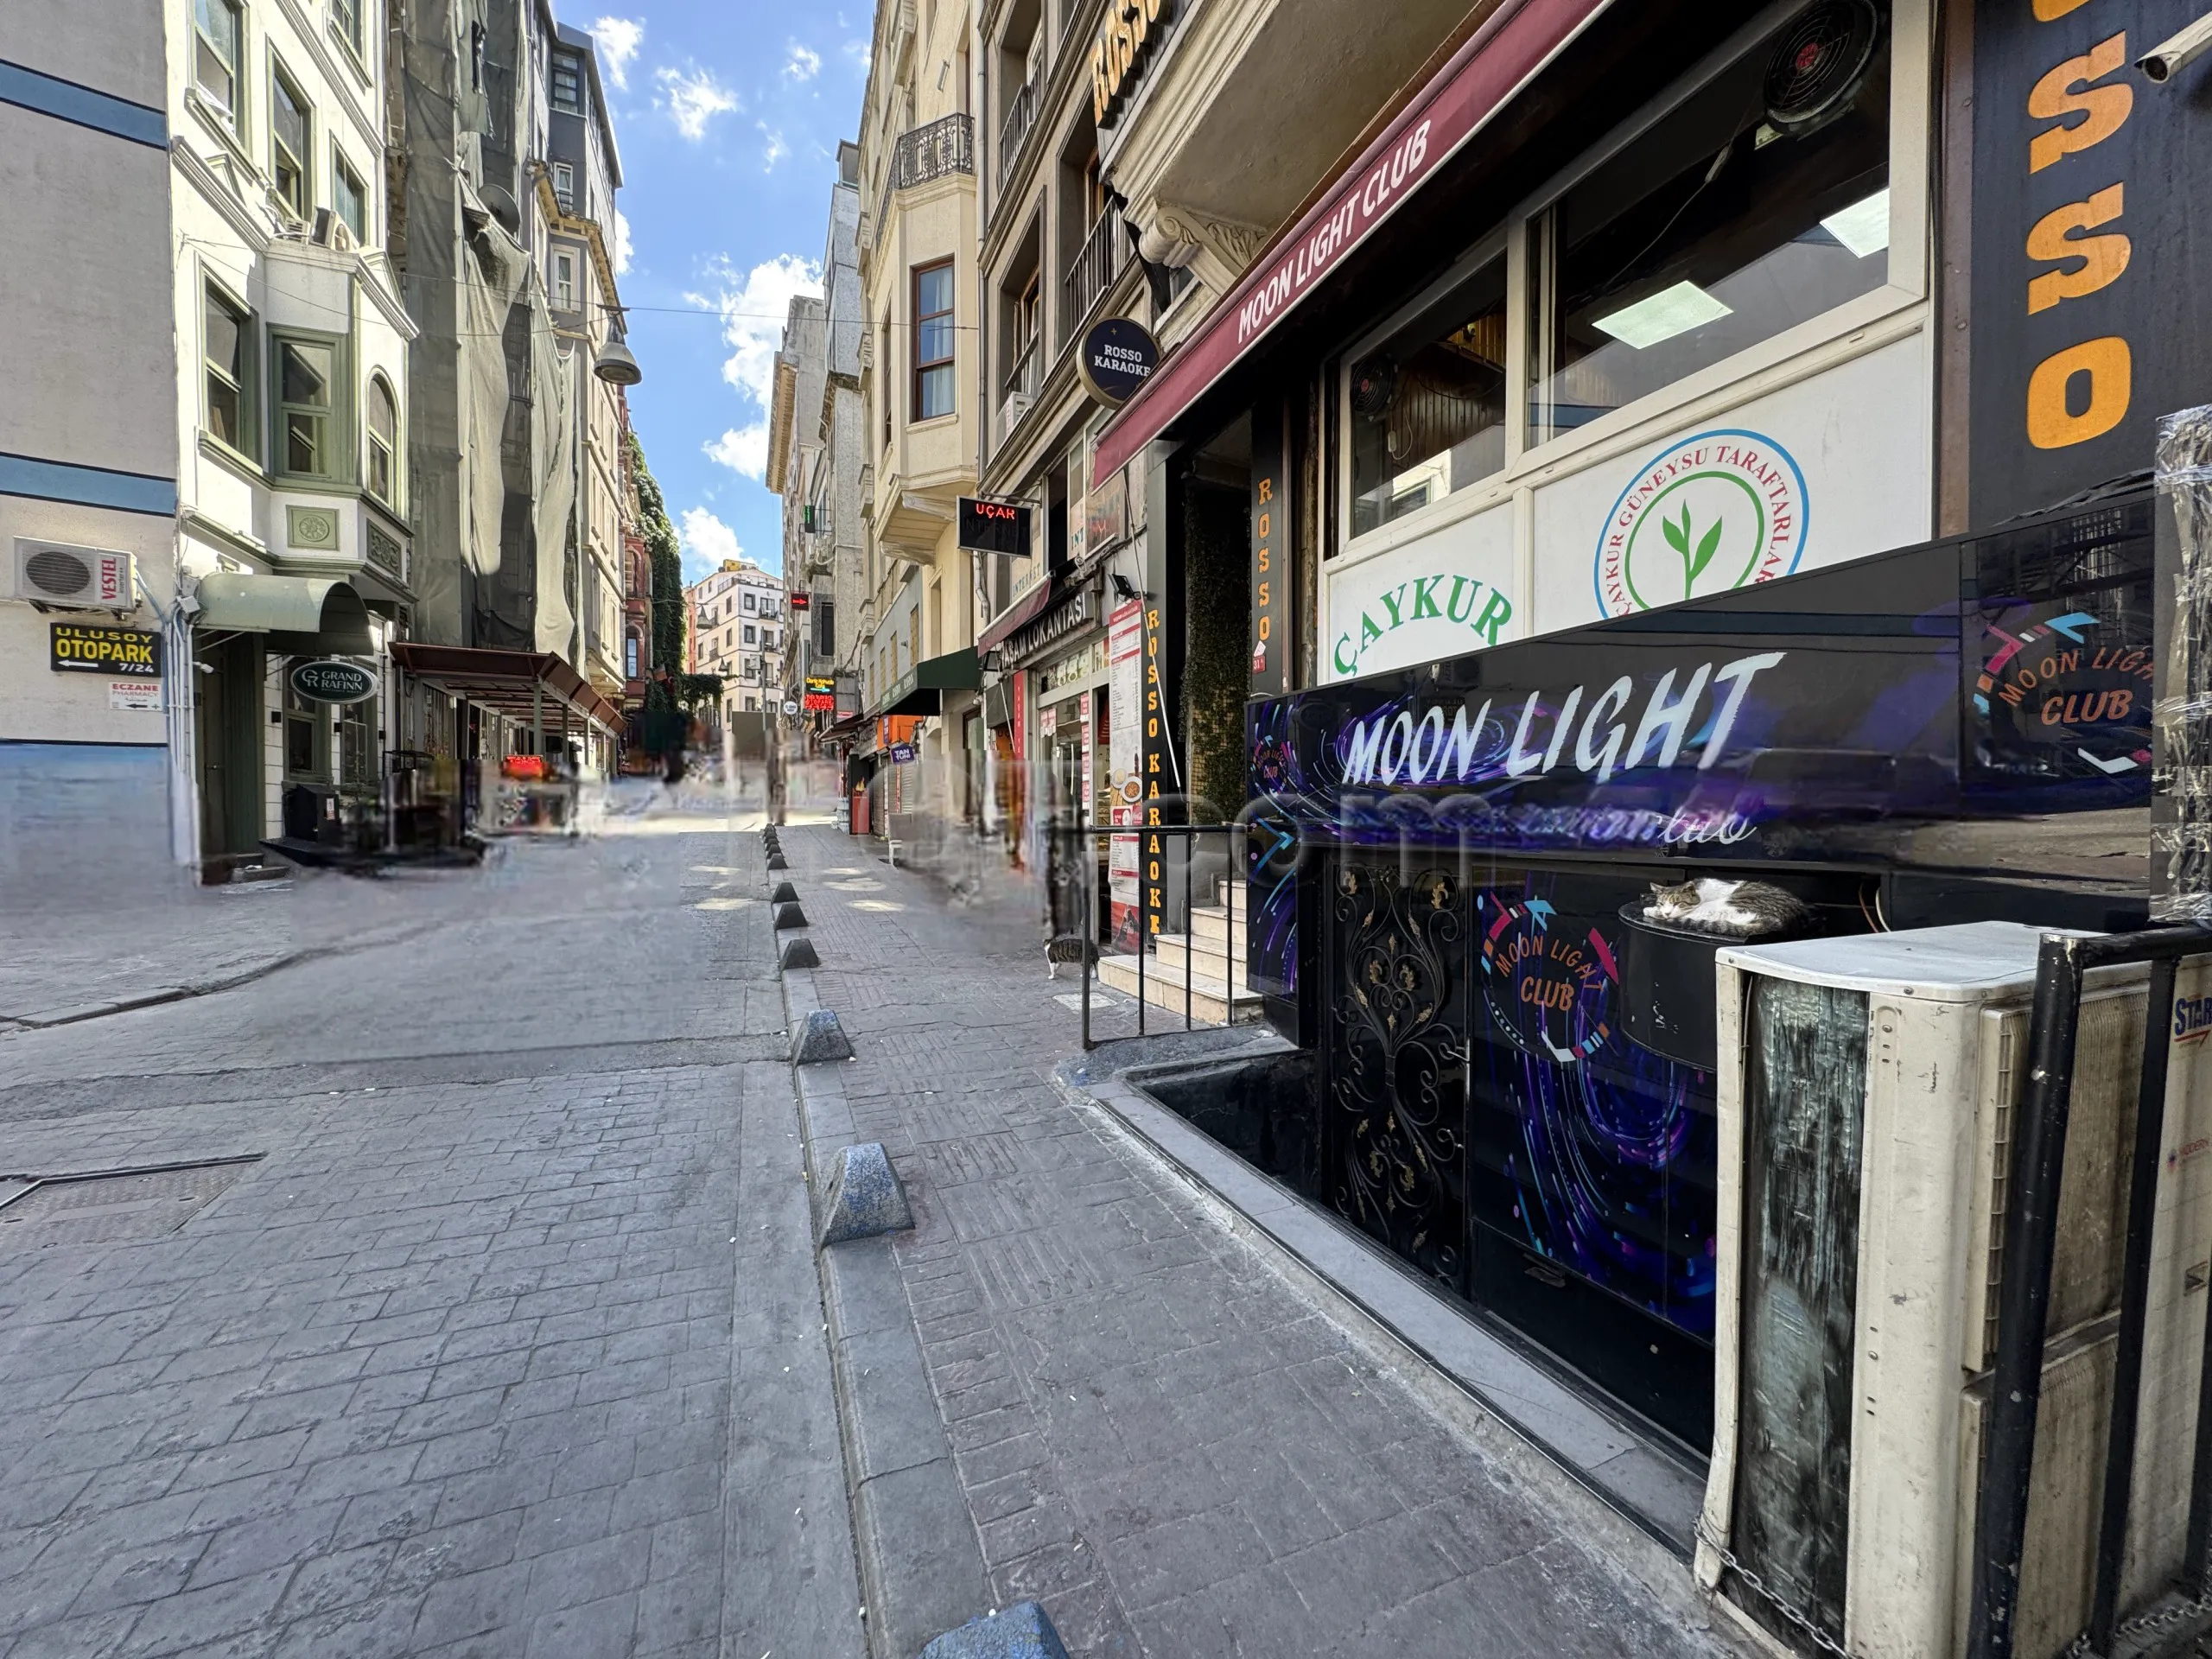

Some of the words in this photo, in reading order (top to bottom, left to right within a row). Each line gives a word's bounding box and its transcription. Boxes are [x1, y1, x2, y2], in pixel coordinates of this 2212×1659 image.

[1090, 0, 1160, 127] ROSS
[1238, 270, 1293, 345] MOON
[1296, 190, 1360, 286] LIGHT
[1363, 119, 1431, 218] CLUB
[2026, 0, 2133, 449] SSO
[1095, 355, 1151, 377] KARAOKE
[1104, 345, 1141, 362] ROSSO
[976, 503, 1015, 520] UÇAR
[1619, 447, 1709, 527] GÜNEYSU
[102, 557, 117, 601] VESTEL
[1258, 478, 1272, 641] ROSSO
[56, 627, 153, 643] ULUSOY
[1028, 592, 1086, 651] LOKANTASI
[1334, 574, 1512, 677] ÇAYKUR
[56, 639, 153, 664] OTOPARK
[119, 663, 154, 673] 7/24
[321, 671, 362, 682] GRAND
[1147, 610, 1160, 738] ROSSO
[1999, 650, 2078, 707] MOON
[2092, 647, 2153, 680] LIGH
[321, 680, 363, 690] RAFINN
[2041, 690, 2133, 725] CLUB
[1342, 698, 1491, 785] MOON
[1507, 652, 1787, 784] LIGHT
[1148, 753, 1160, 935] KARAOKE
[1496, 935, 1543, 977] MOON
[1551, 939, 1604, 992] LIGHT
[1521, 976, 1574, 1011] CLUB
